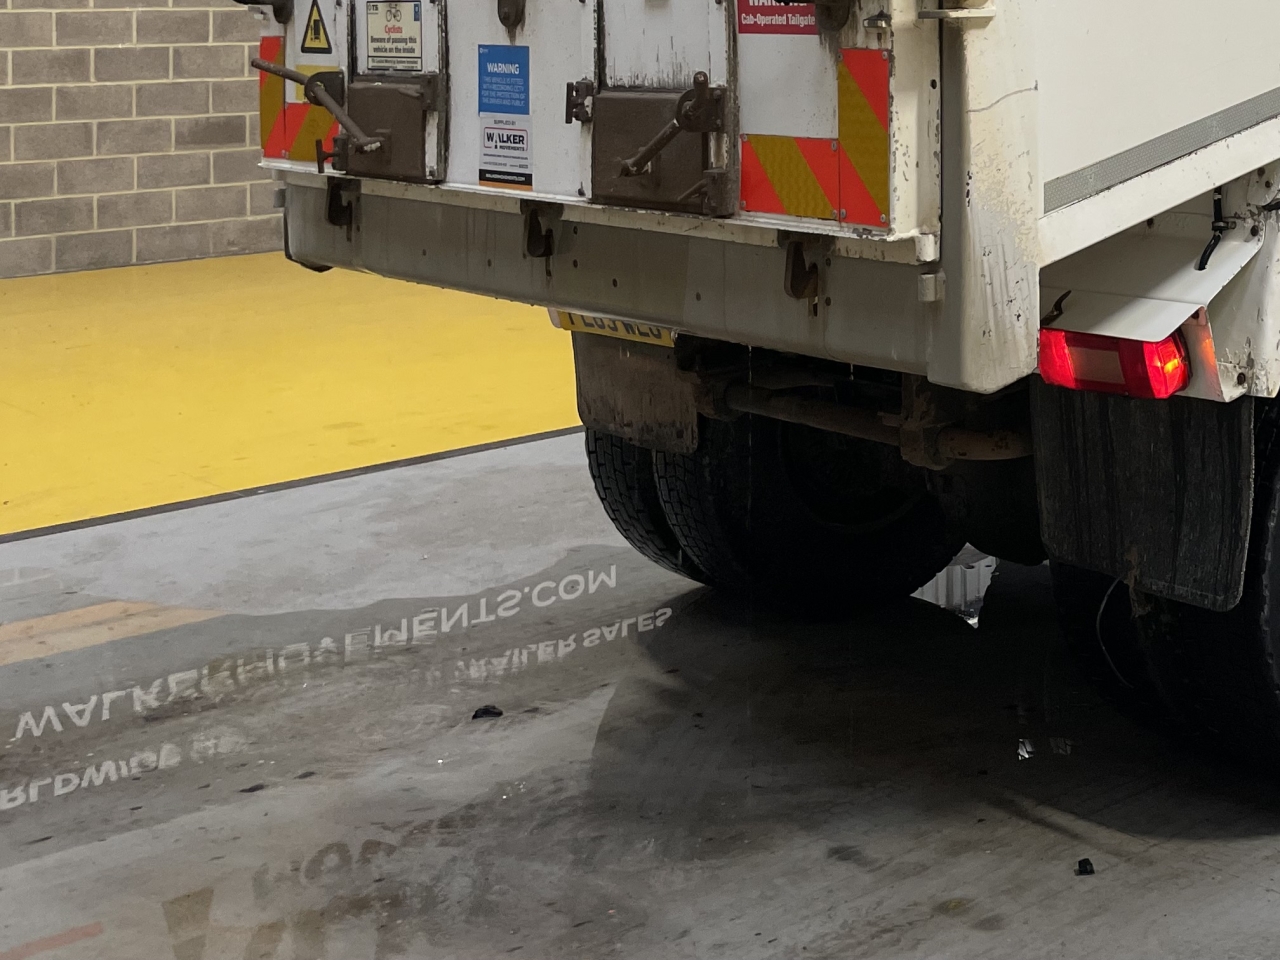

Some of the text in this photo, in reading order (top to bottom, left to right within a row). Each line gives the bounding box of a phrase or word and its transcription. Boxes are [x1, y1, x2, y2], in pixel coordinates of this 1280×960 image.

[741, 13, 816, 27] Cab-Operated Tailgate
[486, 62, 520, 75] WARNING
[486, 131, 525, 149] WALKER
